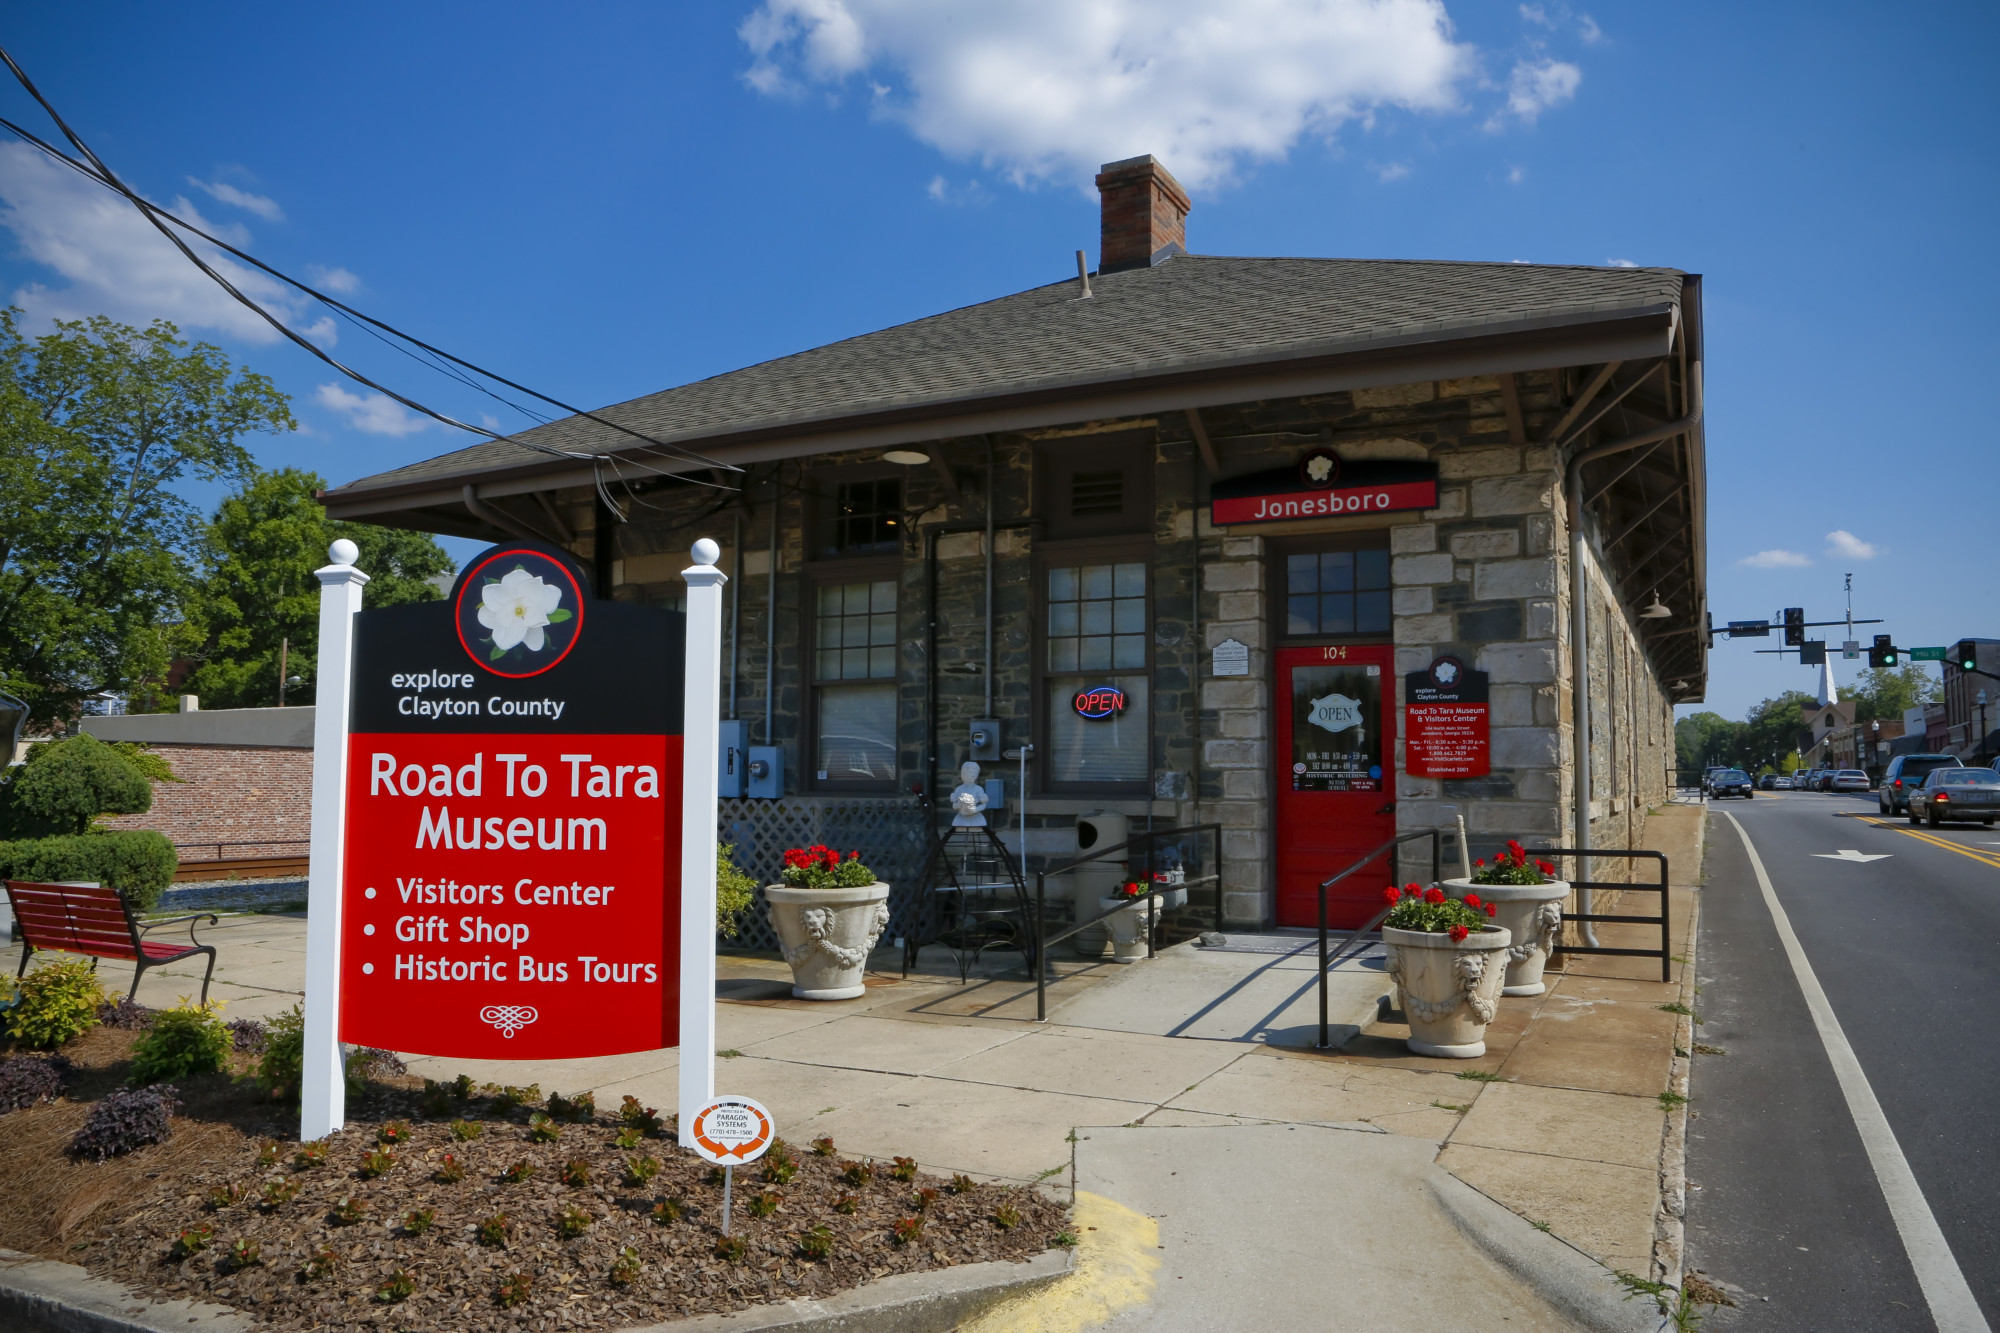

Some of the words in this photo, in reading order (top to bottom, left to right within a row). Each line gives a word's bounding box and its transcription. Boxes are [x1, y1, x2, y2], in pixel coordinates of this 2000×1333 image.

[1255, 493, 1389, 519] Jonesboro
[1324, 646, 1346, 659] 104
[392, 669, 474, 692] explore
[399, 696, 479, 720] Clayton
[488, 697, 566, 721] County
[1076, 694, 1123, 710] OPEN
[1319, 707, 1352, 720] OPEN
[371, 752, 482, 797] Road
[496, 754, 548, 798] To
[561, 754, 660, 799] Tara
[416, 806, 607, 851] Museum
[396, 878, 504, 905] Visitors
[514, 879, 615, 906] Center
[395, 916, 449, 943] Gift
[459, 916, 529, 950] Shop
[394, 954, 507, 982] Historic
[518, 956, 568, 983] Bus
[578, 957, 657, 984] Tours
